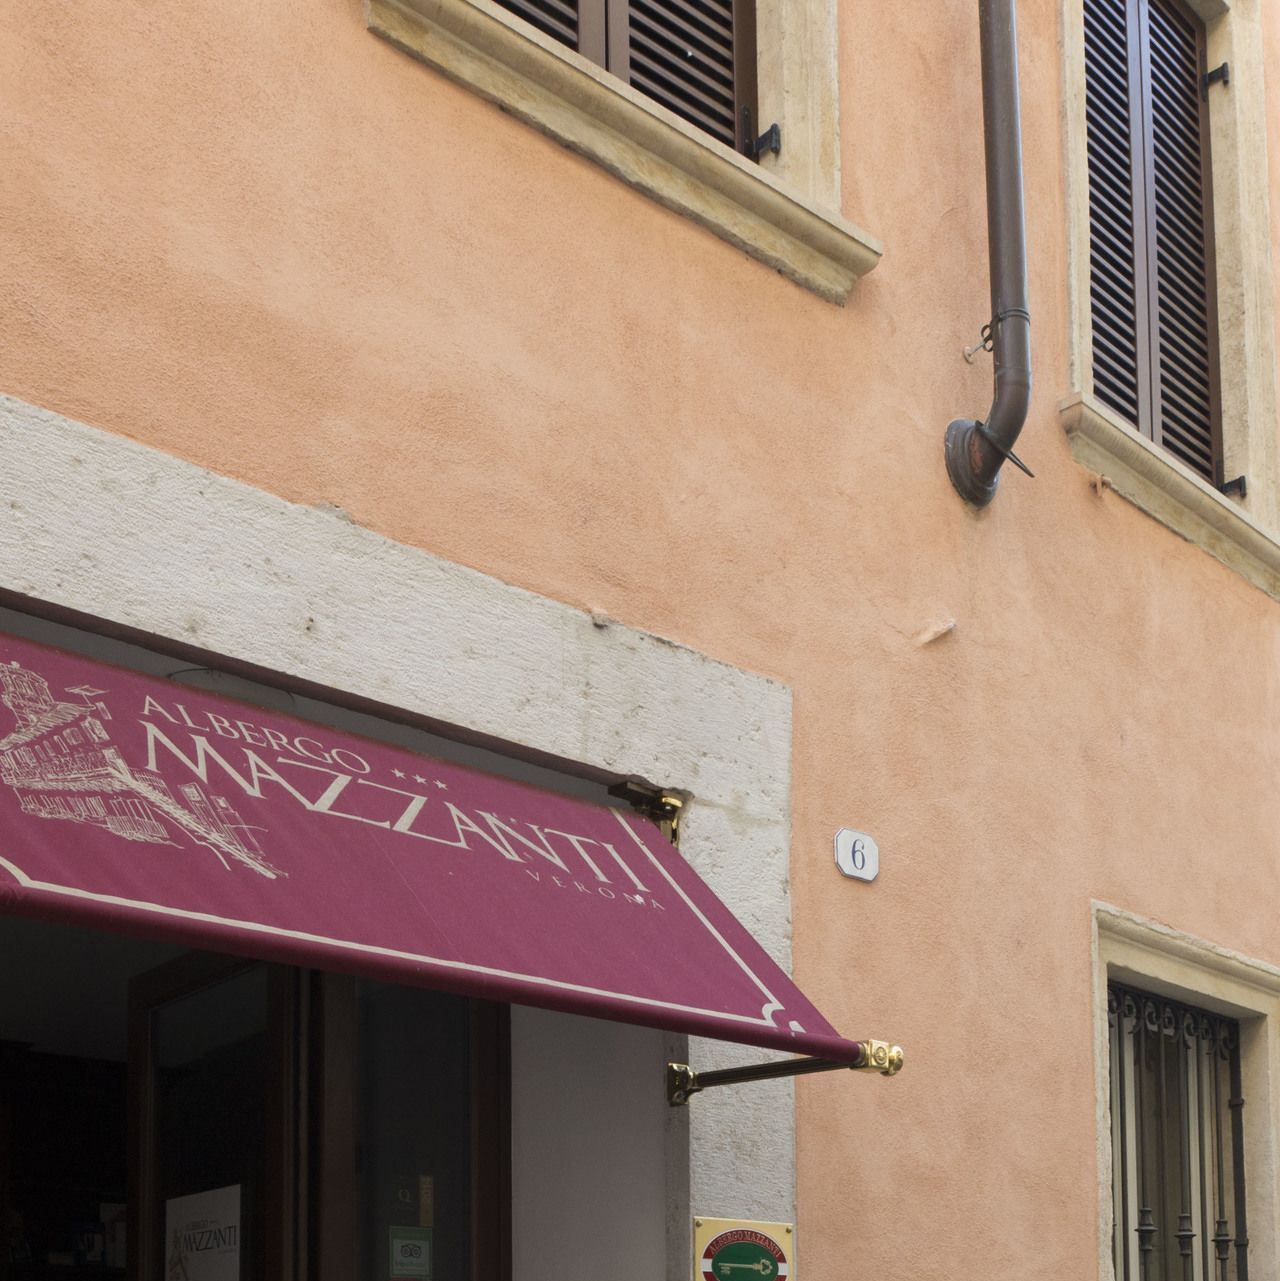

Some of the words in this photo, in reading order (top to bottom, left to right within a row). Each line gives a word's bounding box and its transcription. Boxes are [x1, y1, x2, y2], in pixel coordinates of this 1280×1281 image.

[140, 695, 371, 774] ALBERGO
[137, 719, 651, 893] MAZZANTI
[851, 838, 866, 871] 6
[525, 869, 665, 911] VERONA
[709, 1231, 744, 1256] ALBERGO
[744, 1231, 782, 1258] MAZZANTI
